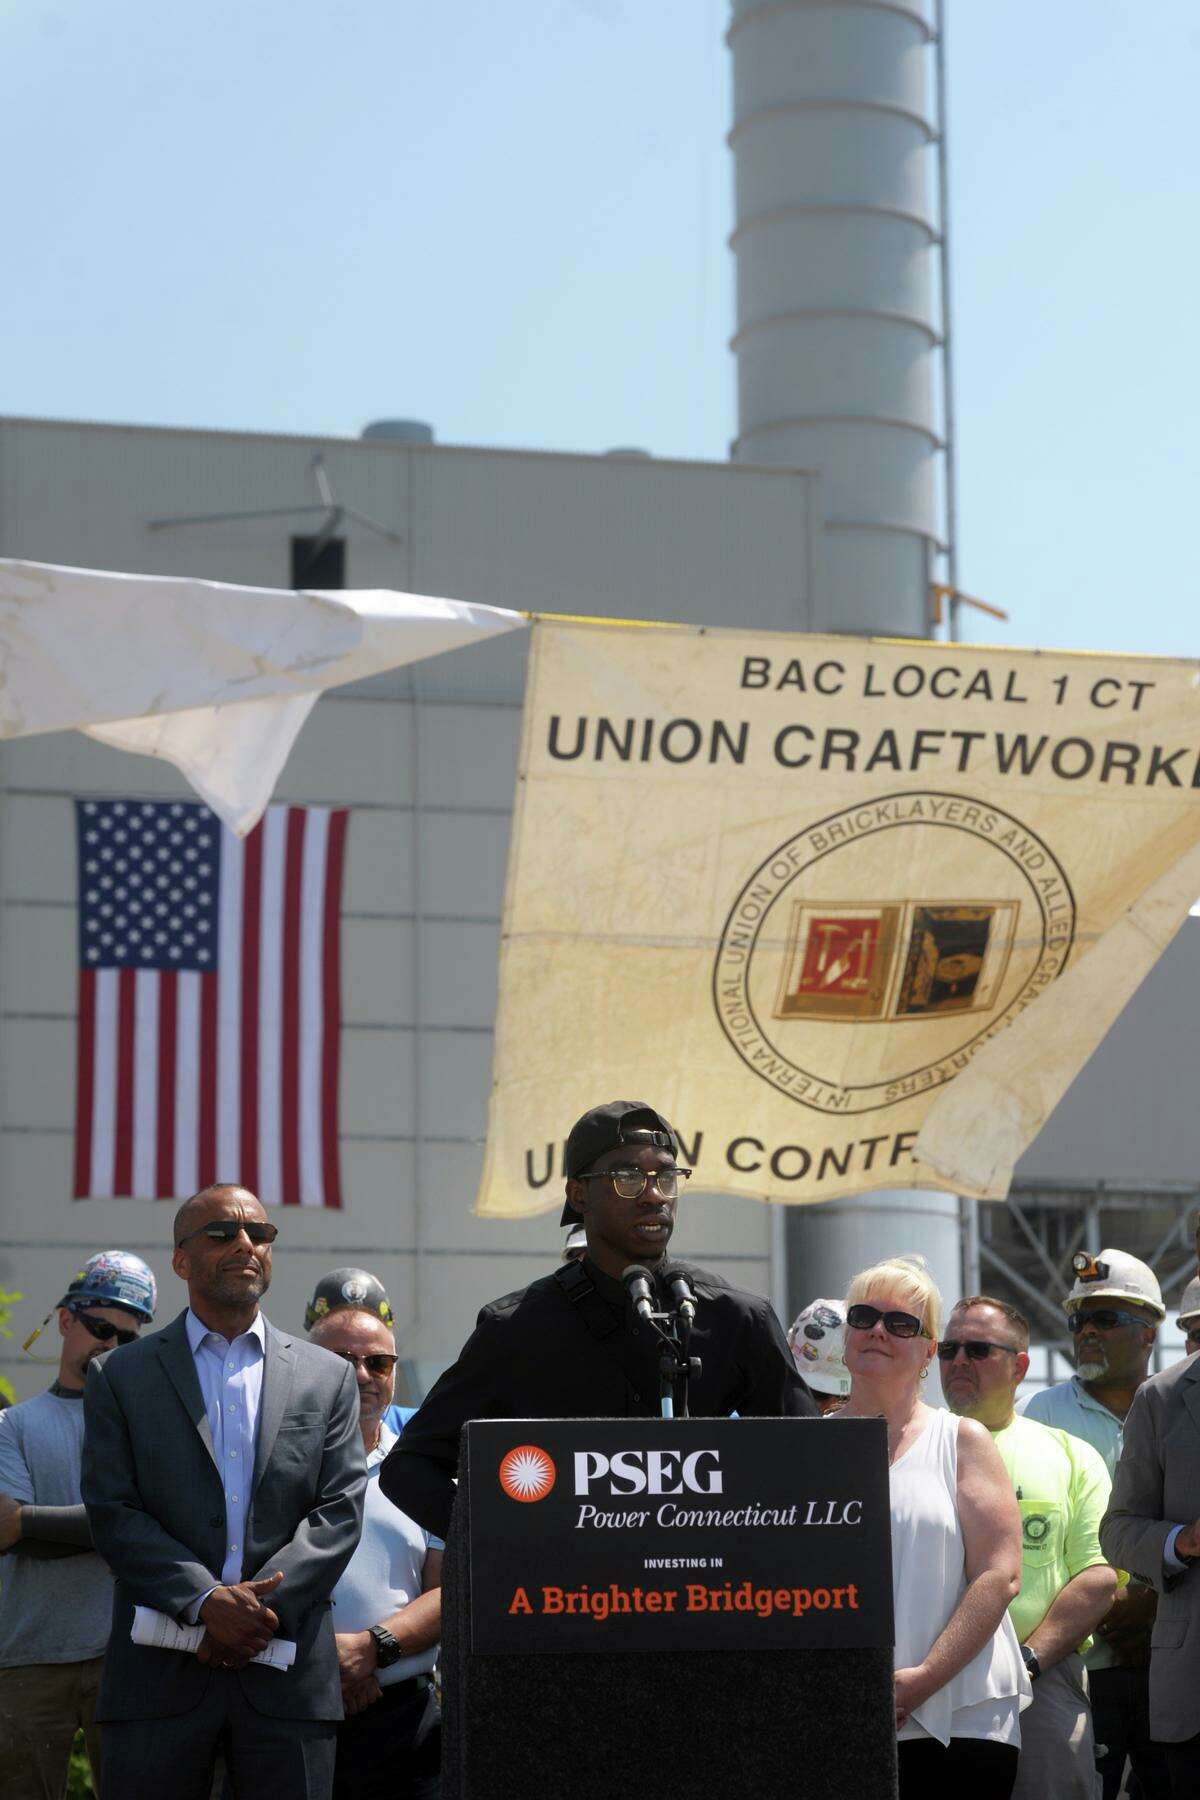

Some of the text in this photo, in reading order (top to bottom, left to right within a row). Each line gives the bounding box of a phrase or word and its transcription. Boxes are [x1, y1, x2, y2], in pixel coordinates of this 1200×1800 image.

[740, 656, 1156, 712] BAC LOCAL 1 CT
[546, 715, 750, 766] UNION
[807, 798, 999, 852] BRICKLAYERS
[770, 847, 803, 881] OF
[1000, 829, 1047, 871] AND
[725, 883, 773, 965] UNION
[1038, 876, 1069, 951] ALLIED
[722, 972, 852, 1108] INTERNATIONAL
[573, 1449, 723, 1496] PSEG
[574, 1500, 864, 1530] Power Connecticut LLC
[643, 1557, 724, 1569] INVESTING IN
[508, 1582, 859, 1621] A Brighter Bridgeport
